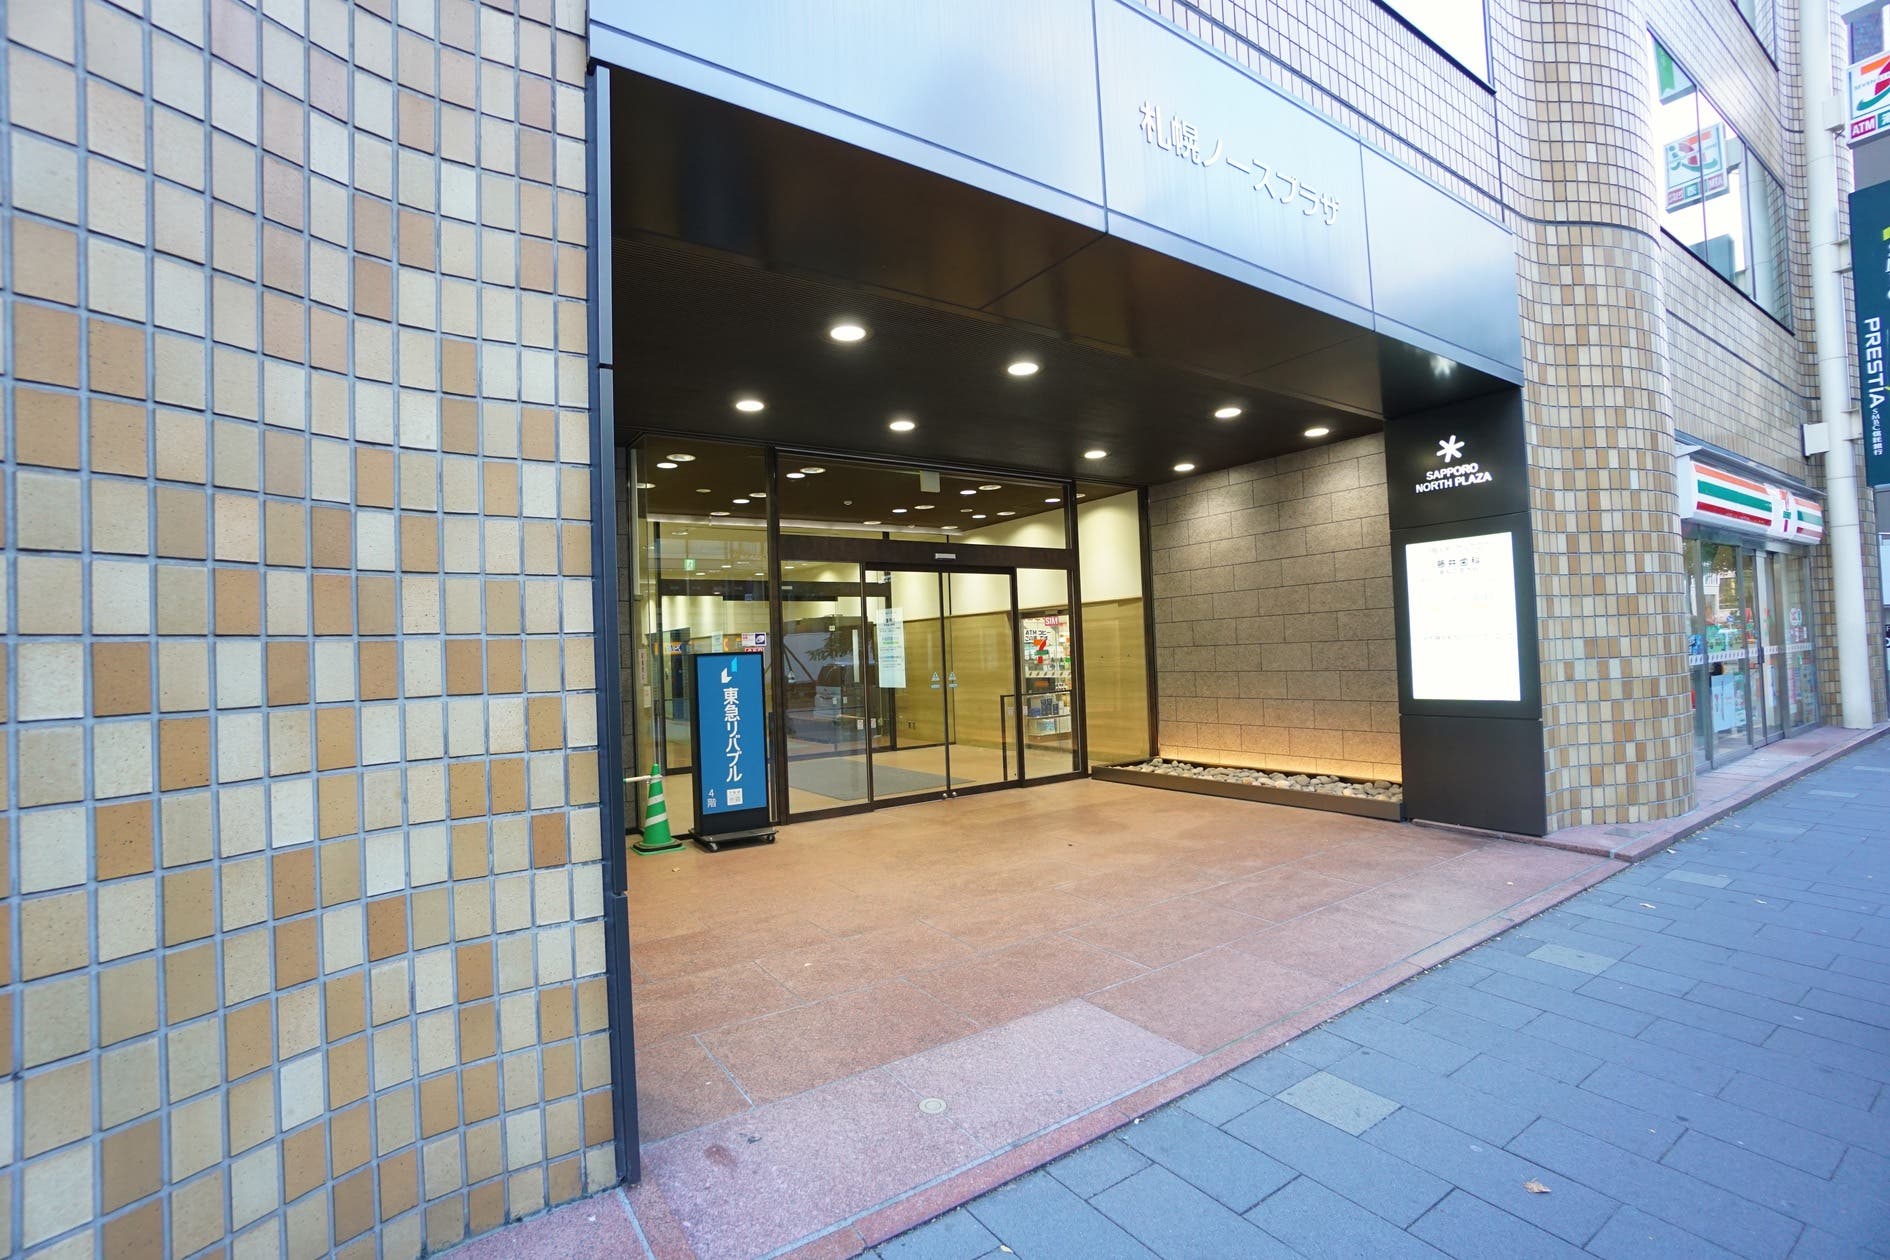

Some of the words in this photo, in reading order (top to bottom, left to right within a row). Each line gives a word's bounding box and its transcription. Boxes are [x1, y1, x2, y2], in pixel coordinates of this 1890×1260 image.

[1852, 118, 1876, 136] ATM
[1138, 99, 1341, 225] 札幌ノースプラザ
[1864, 317, 1885, 408] PRESTIA
[1415, 479, 1453, 493] NORTH
[1454, 471, 1493, 487] PLAZA
[1425, 462, 1479, 480] SAPPORO
[723, 687, 743, 782] 東急リバブル
